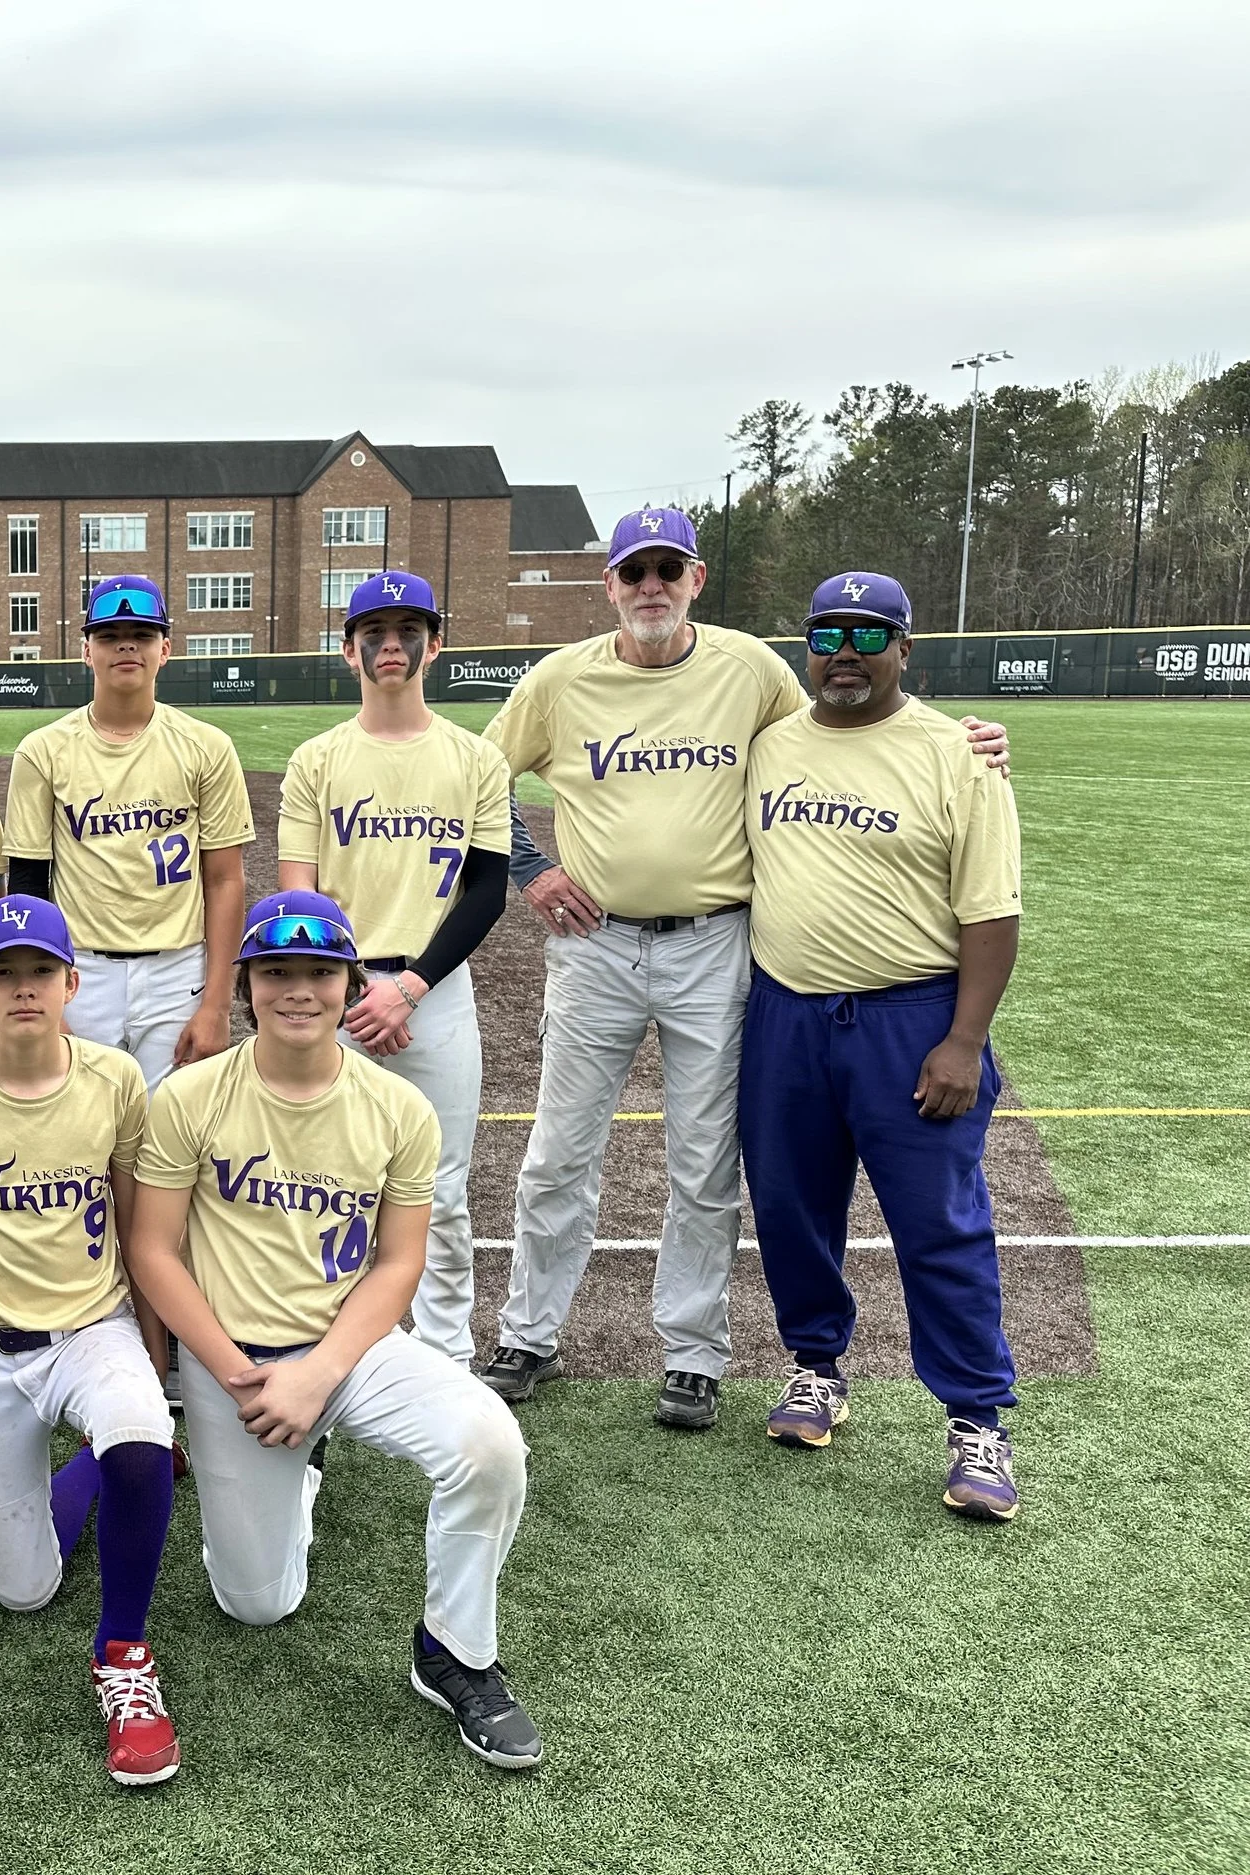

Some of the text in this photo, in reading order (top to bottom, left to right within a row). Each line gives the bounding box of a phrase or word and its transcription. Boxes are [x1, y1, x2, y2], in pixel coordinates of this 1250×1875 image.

[640, 513, 663, 533] LV
[381, 576, 407, 601] LV
[841, 578, 870, 602] LV
[449, 660, 534, 680] Dunwood
[998, 660, 1049, 674] RGRE
[1155, 650, 1198, 672] DSB
[213, 680, 255, 689] HUDGINS
[584, 723, 737, 780] VIKINGS
[640, 736, 706, 749] LAKESIDE
[108, 798, 163, 812] LAKESIDE
[760, 773, 899, 834] VIKINGS
[805, 789, 867, 804] LAKESIDE
[64, 788, 189, 841] VIKINGS
[330, 789, 465, 847] VIKINGS
[378, 804, 437, 815] LAKESIDE
[147, 833, 192, 887] 12
[429, 846, 463, 898] 7
[1, 901, 32, 930] LV
[22, 1165, 93, 1183] LAKESIDE
[210, 1146, 379, 1222] VIKINGS
[274, 1166, 344, 1187] LAKESIDE
[83, 1197, 107, 1261] 9
